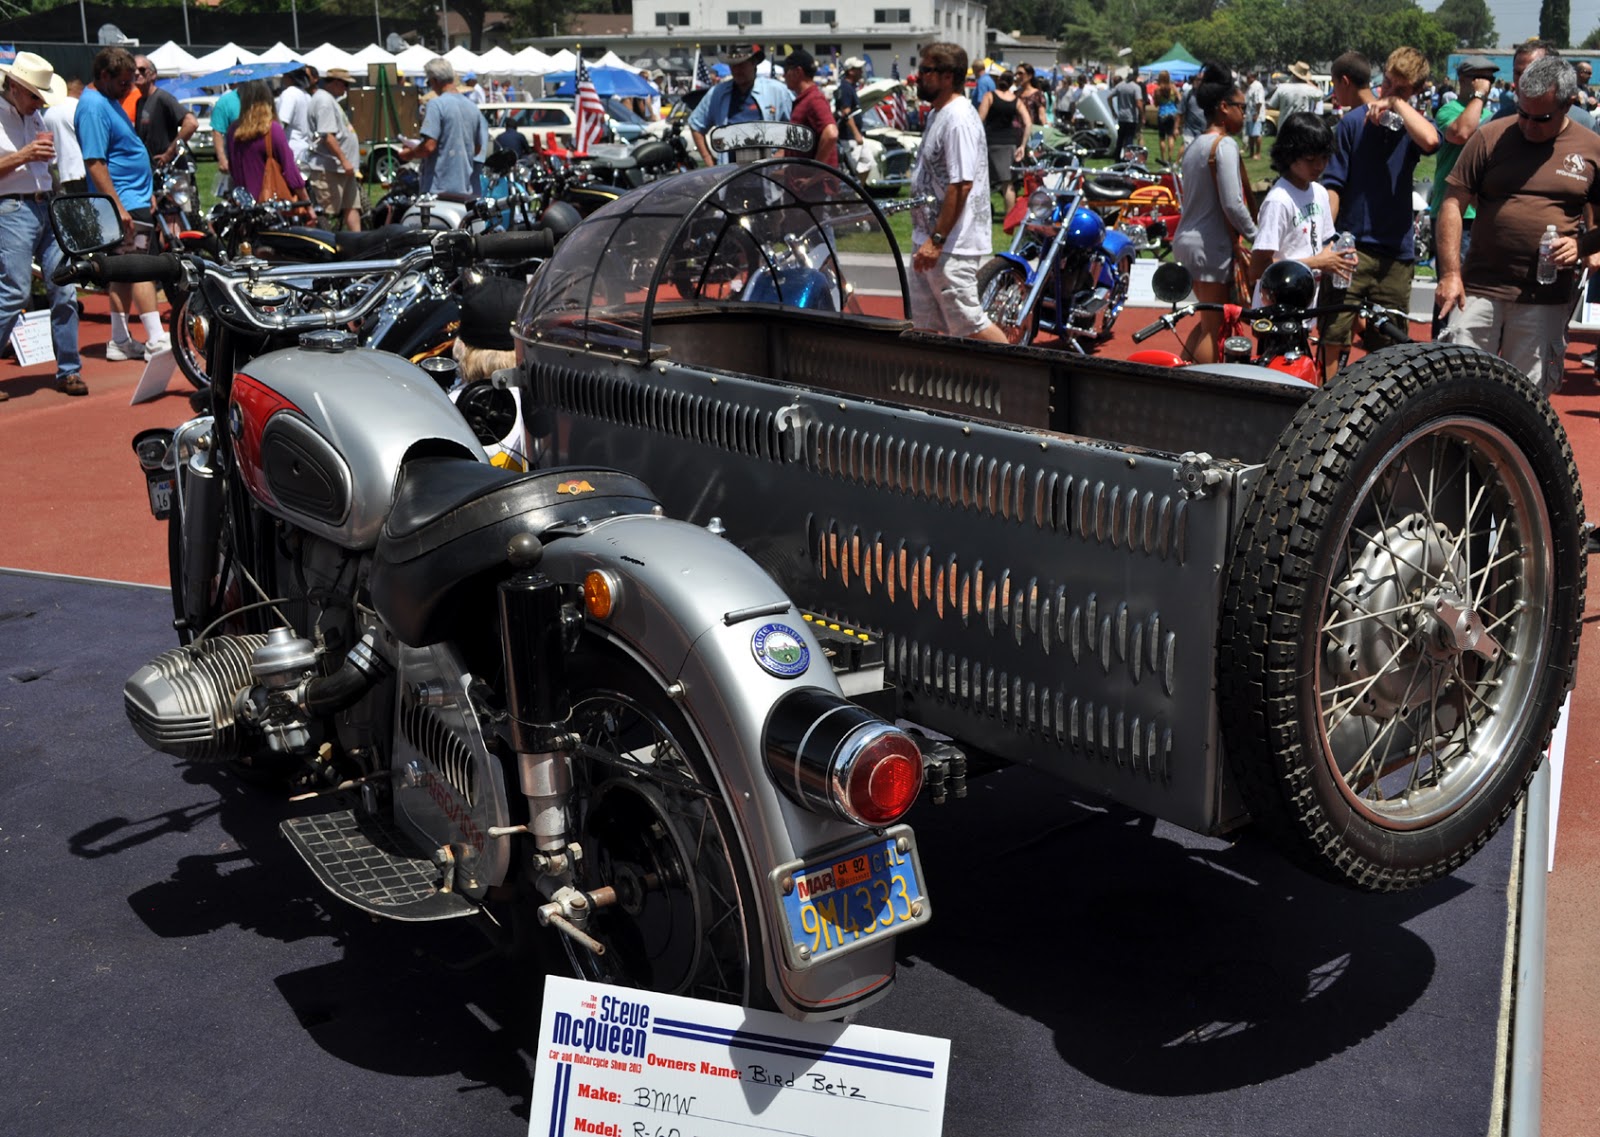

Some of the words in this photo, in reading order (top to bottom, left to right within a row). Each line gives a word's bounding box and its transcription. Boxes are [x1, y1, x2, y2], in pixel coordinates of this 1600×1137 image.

[755, 627, 770, 649] GUTE
[797, 872, 833, 899] MAR
[837, 864, 848, 875] CA
[853, 857, 865, 873] 92
[872, 846, 905, 873] CAL
[801, 875, 912, 952] 9M4333
[581, 1001, 597, 1010] Friends
[600, 995, 650, 1029] Steve
[549, 1050, 560, 1060] Car
[561, 1053, 573, 1063] and
[574, 1053, 609, 1069] Motorcycle
[611, 1060, 627, 1072] Show
[628, 1062, 642, 1074] 2013
[647, 1053, 697, 1073] Owners
[700, 1061, 742, 1080] Name:
[806, 1073, 866, 1099] Betz
[578, 1083, 622, 1104] Make:
[633, 1087, 697, 1116] BMW
[574, 1117, 622, 1137] Model:
